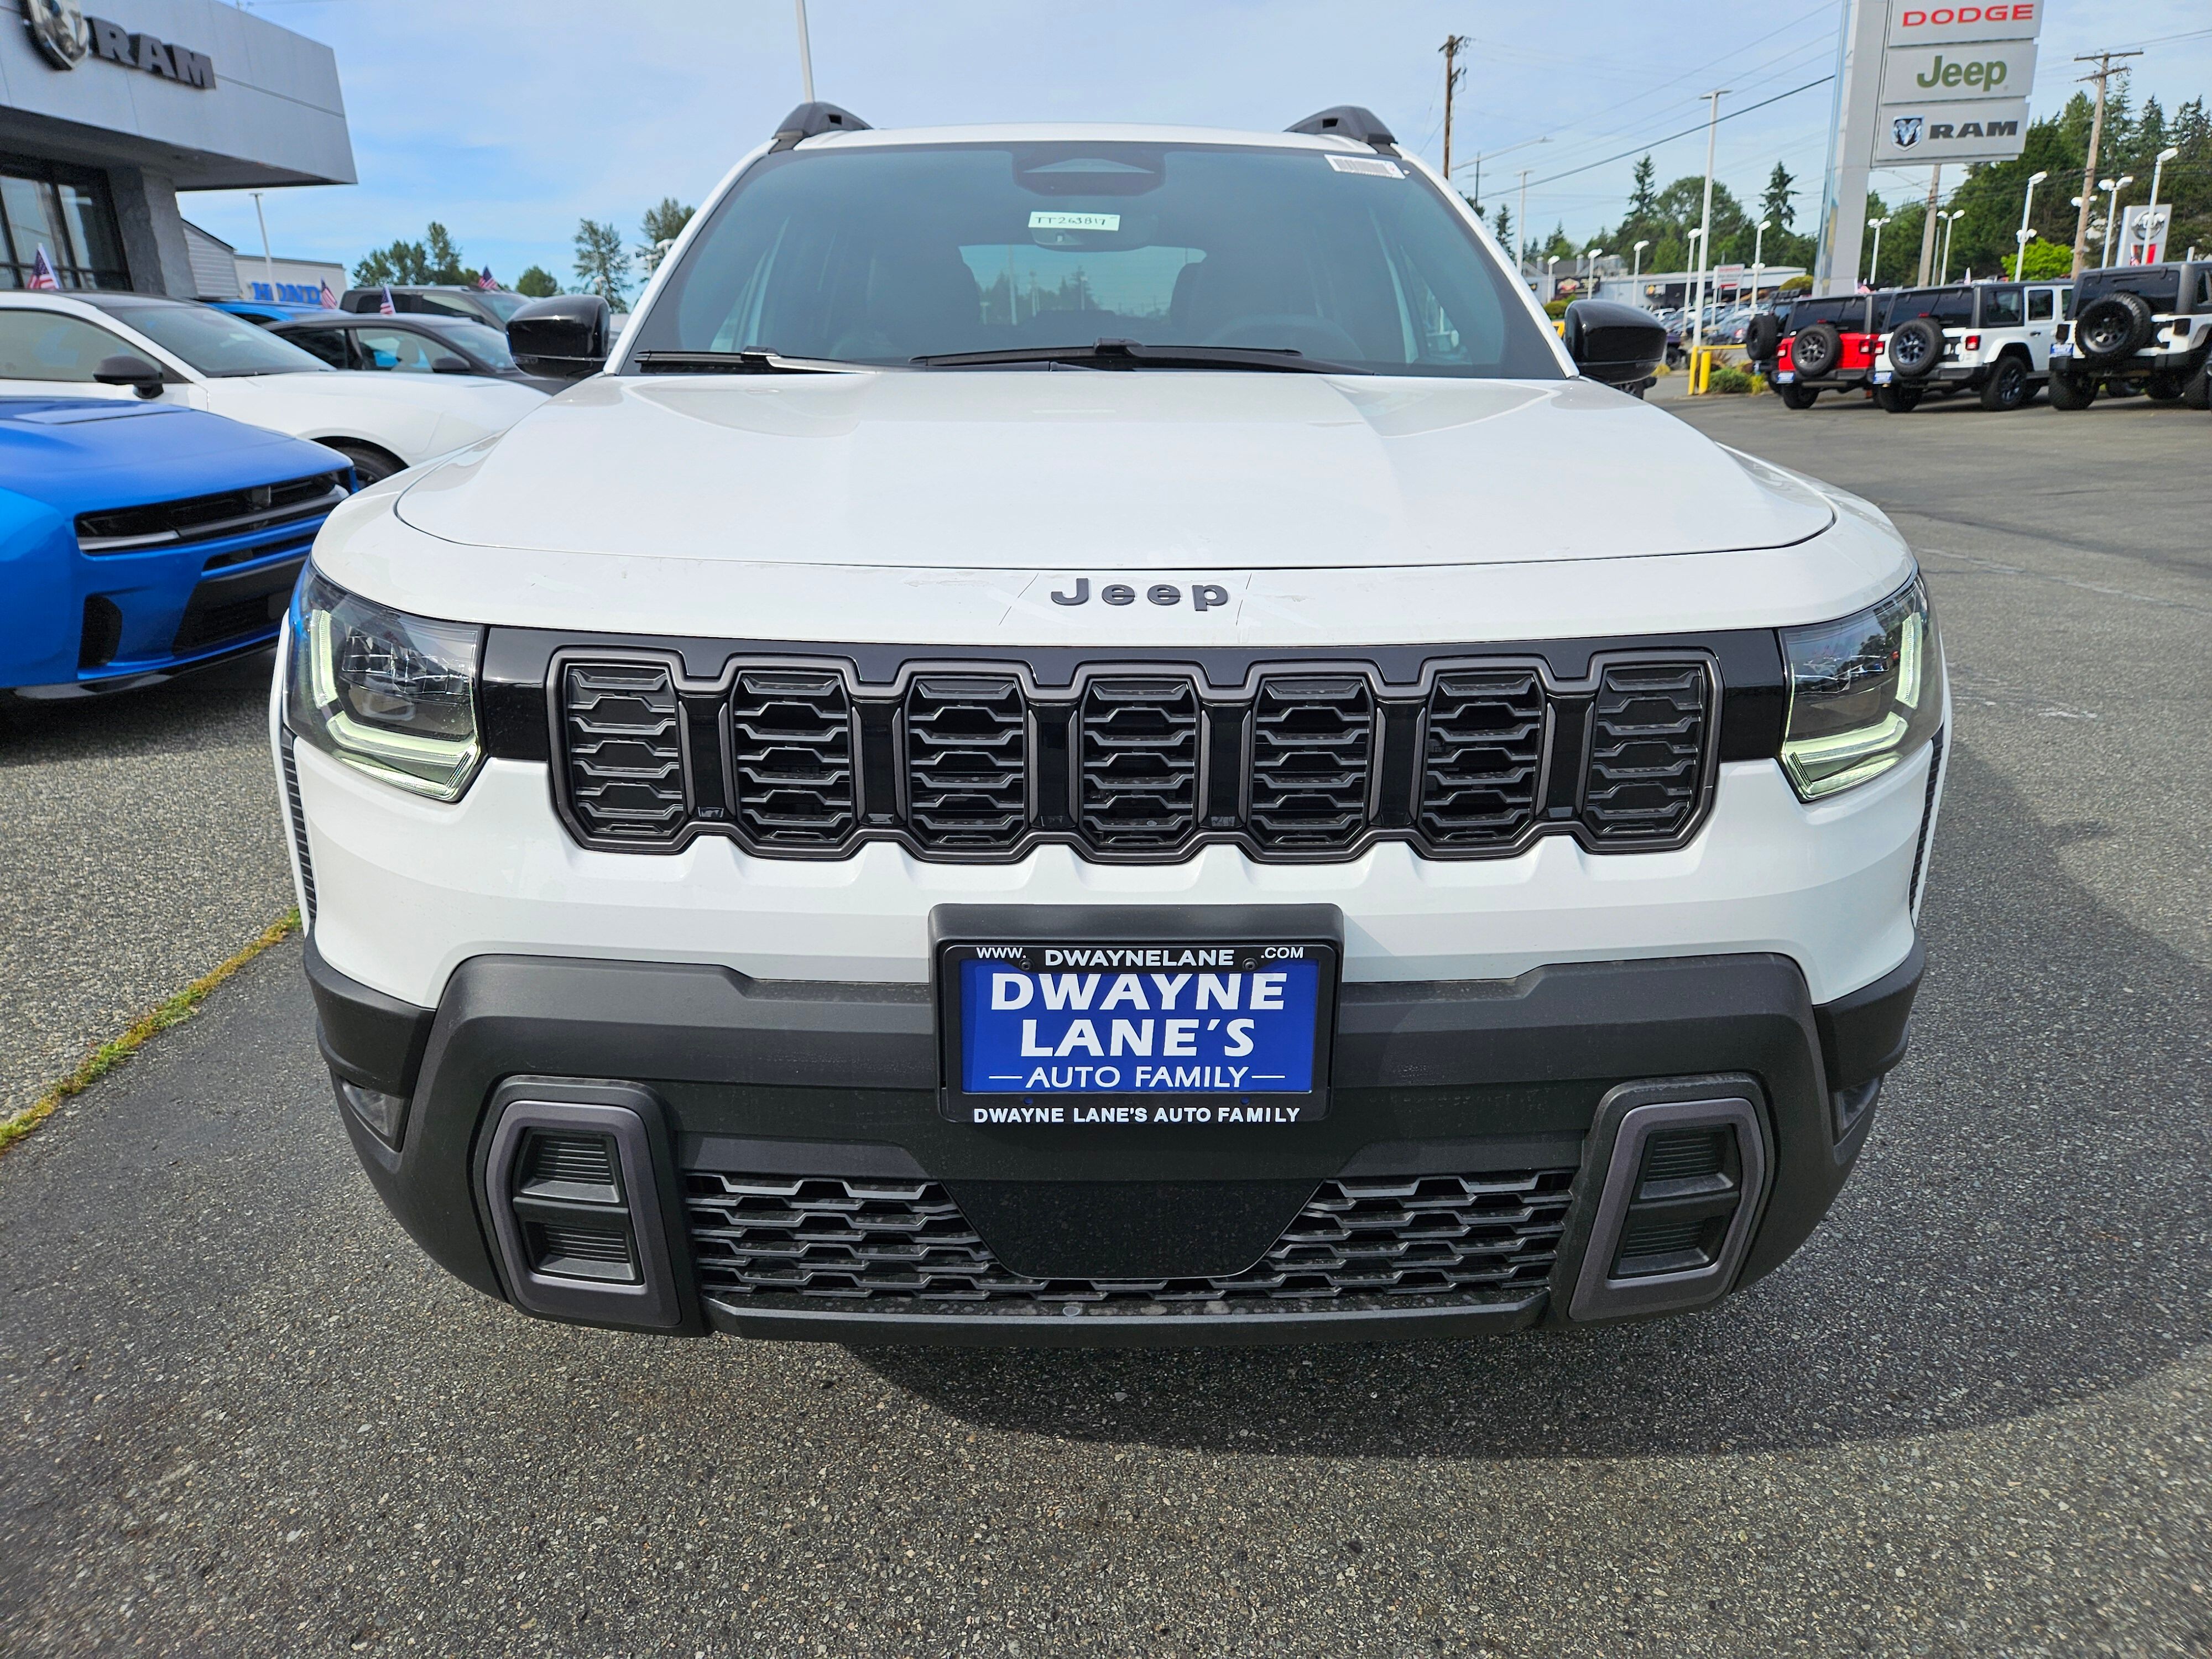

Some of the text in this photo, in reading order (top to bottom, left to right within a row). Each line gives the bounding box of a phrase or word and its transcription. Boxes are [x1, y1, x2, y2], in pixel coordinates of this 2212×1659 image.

[1902, 4, 2034, 27] DODGE
[84, 16, 216, 90] RAM
[1917, 55, 2007, 92] Jeep
[1929, 121, 2018, 139] RAM
[252, 282, 320, 305] HOND
[1051, 578, 1228, 612] Jeep
[976, 947, 1304, 966] WWW. DWAYNELANE .COM
[991, 973, 1287, 1010] DWAYNE
[1021, 1019, 1255, 1057] LANE'S
[1026, 1066, 1249, 1087] AUTO FAMILY
[974, 1108, 1300, 1123] DWAYNE LANE'S AUTO FAMILY
